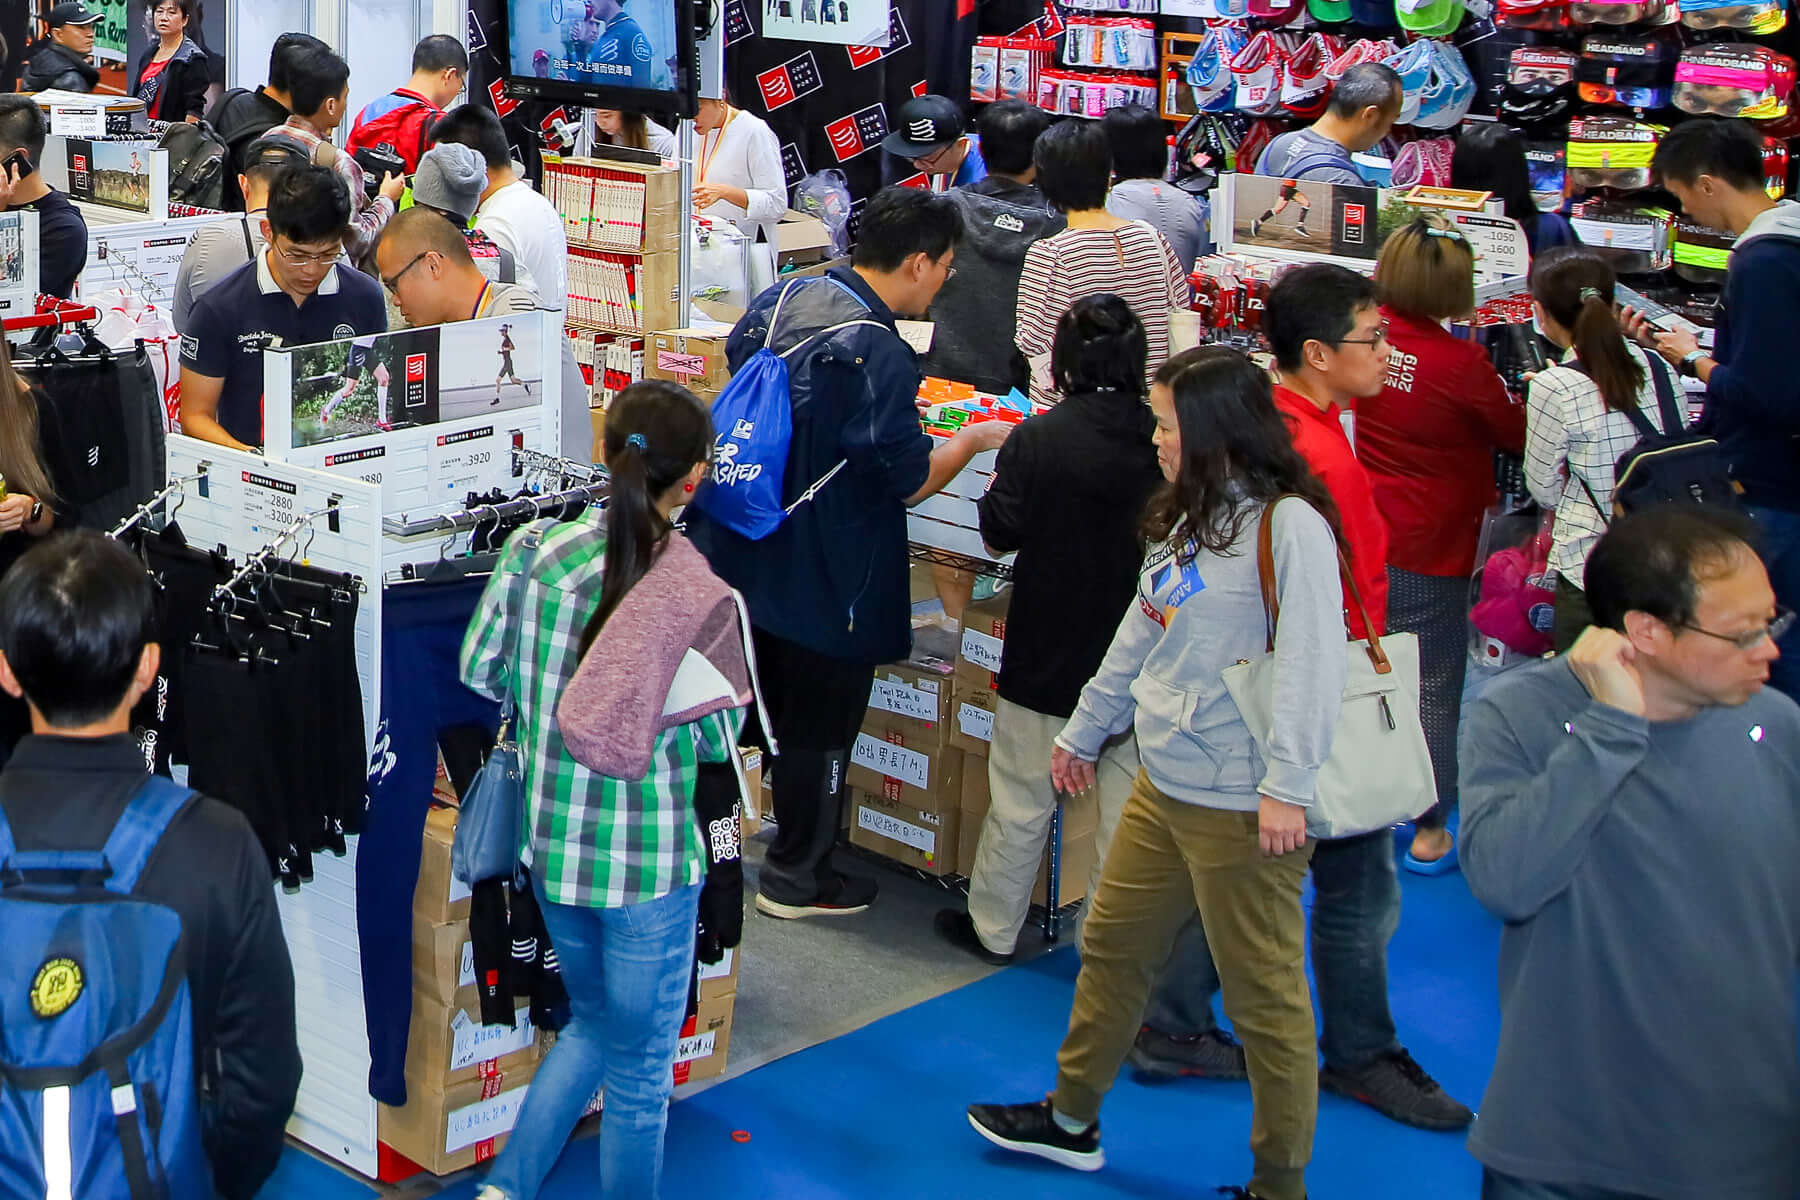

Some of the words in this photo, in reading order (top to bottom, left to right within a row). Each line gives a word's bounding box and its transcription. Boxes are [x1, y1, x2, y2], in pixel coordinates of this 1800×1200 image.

[1586, 44, 1646, 57] HEADBAND
[1583, 131, 1655, 142] HEADBAND
[1397, 352, 1419, 394] 2019
